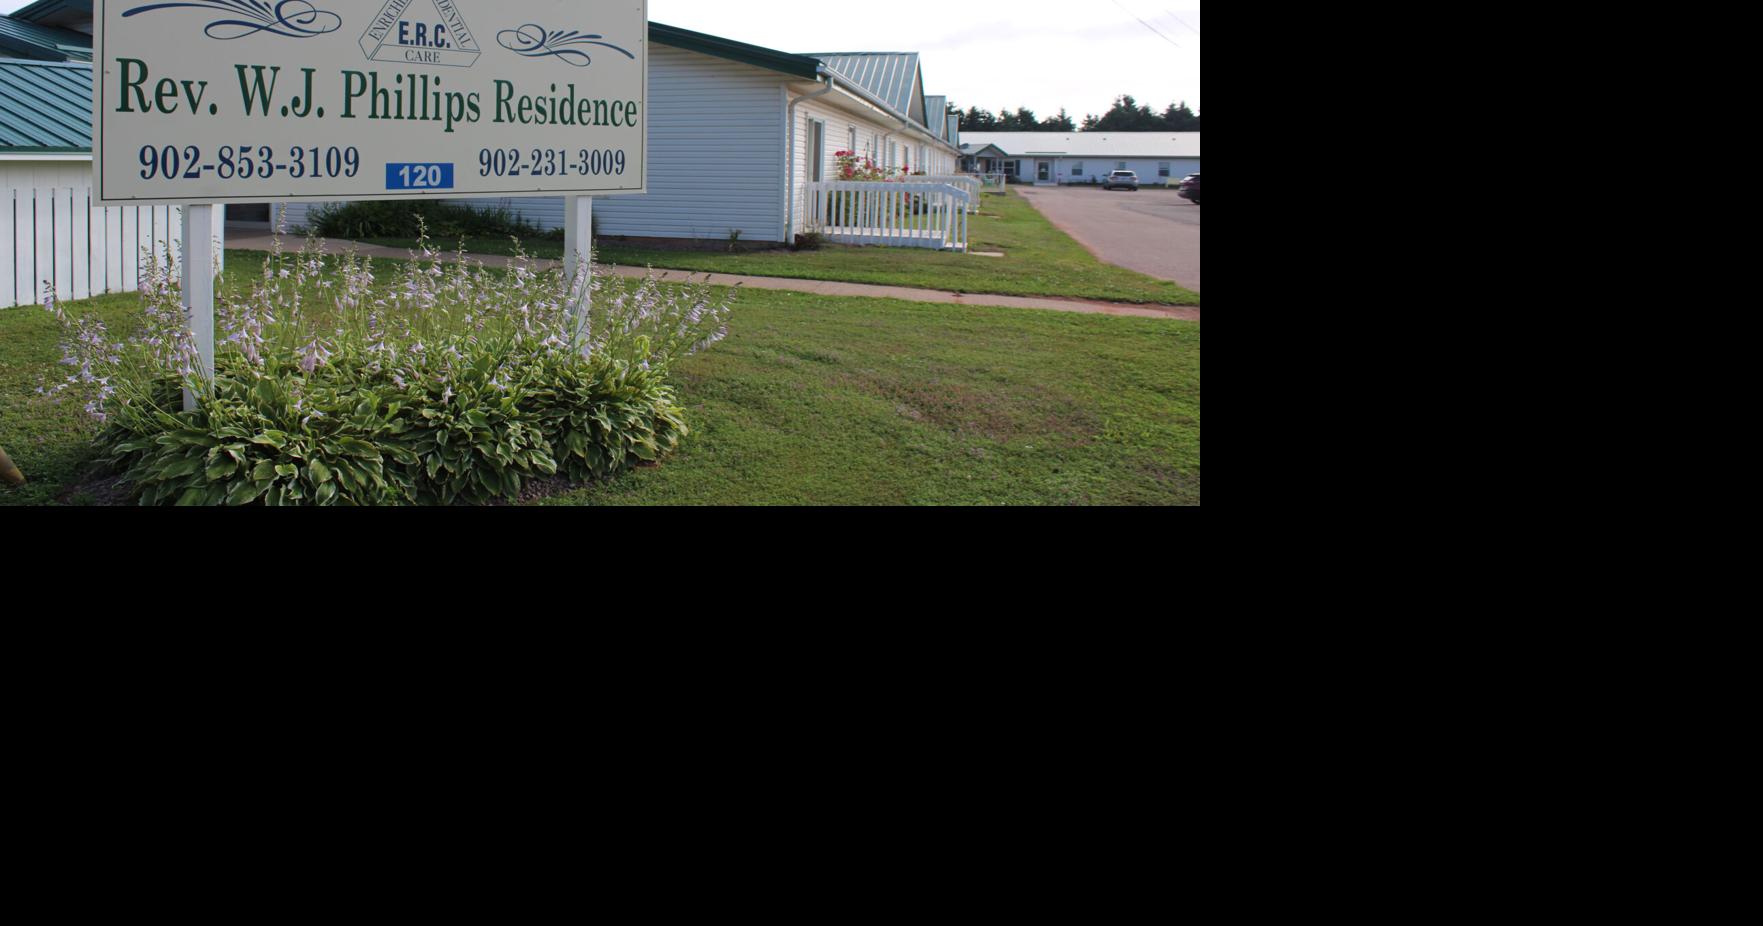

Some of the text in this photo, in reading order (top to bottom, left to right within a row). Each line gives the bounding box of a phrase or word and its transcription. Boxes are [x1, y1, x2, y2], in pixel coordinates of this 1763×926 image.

[398, 20, 451, 48] E.R.C.
[436, 0, 471, 47] DENTIAL
[405, 49, 441, 63] CARE
[115, 57, 637, 133] Rev. W.J. Phillips Residence
[139, 144, 360, 180] 902-853-3109
[399, 165, 442, 187] 120
[478, 148, 626, 177] 902-231-3009
